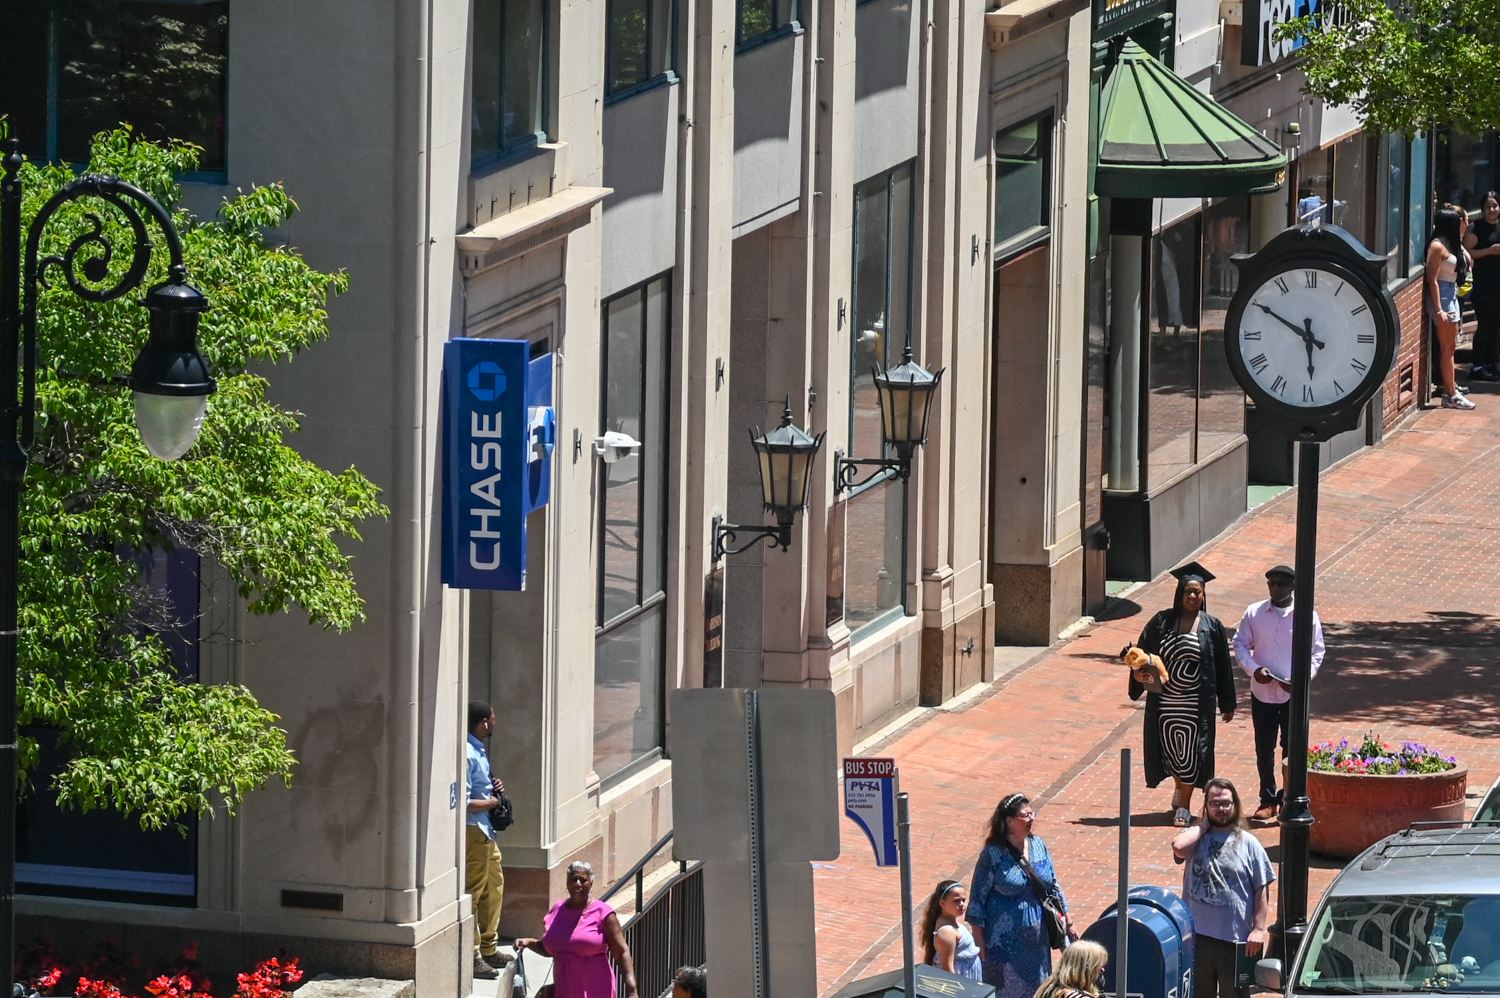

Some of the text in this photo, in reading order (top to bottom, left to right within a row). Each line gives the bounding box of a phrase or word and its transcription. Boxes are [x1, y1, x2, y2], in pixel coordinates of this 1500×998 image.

[1274, 277, 1290, 296] XI
[1304, 271, 1317, 289] XII
[1334, 282, 1344, 297] I
[1351, 304, 1367, 316] II
[1244, 331, 1261, 341] IX
[1357, 334, 1374, 344] III
[1249, 353, 1268, 376] VIII
[1351, 358, 1367, 377] IV
[1270, 375, 1287, 396] VII
[1302, 384, 1314, 402] VI
[1333, 380, 1344, 396] V
[470, 410, 502, 570] CHASE
[846, 762, 892, 774] BUS STOP
[850, 781, 880, 792] PVTA
